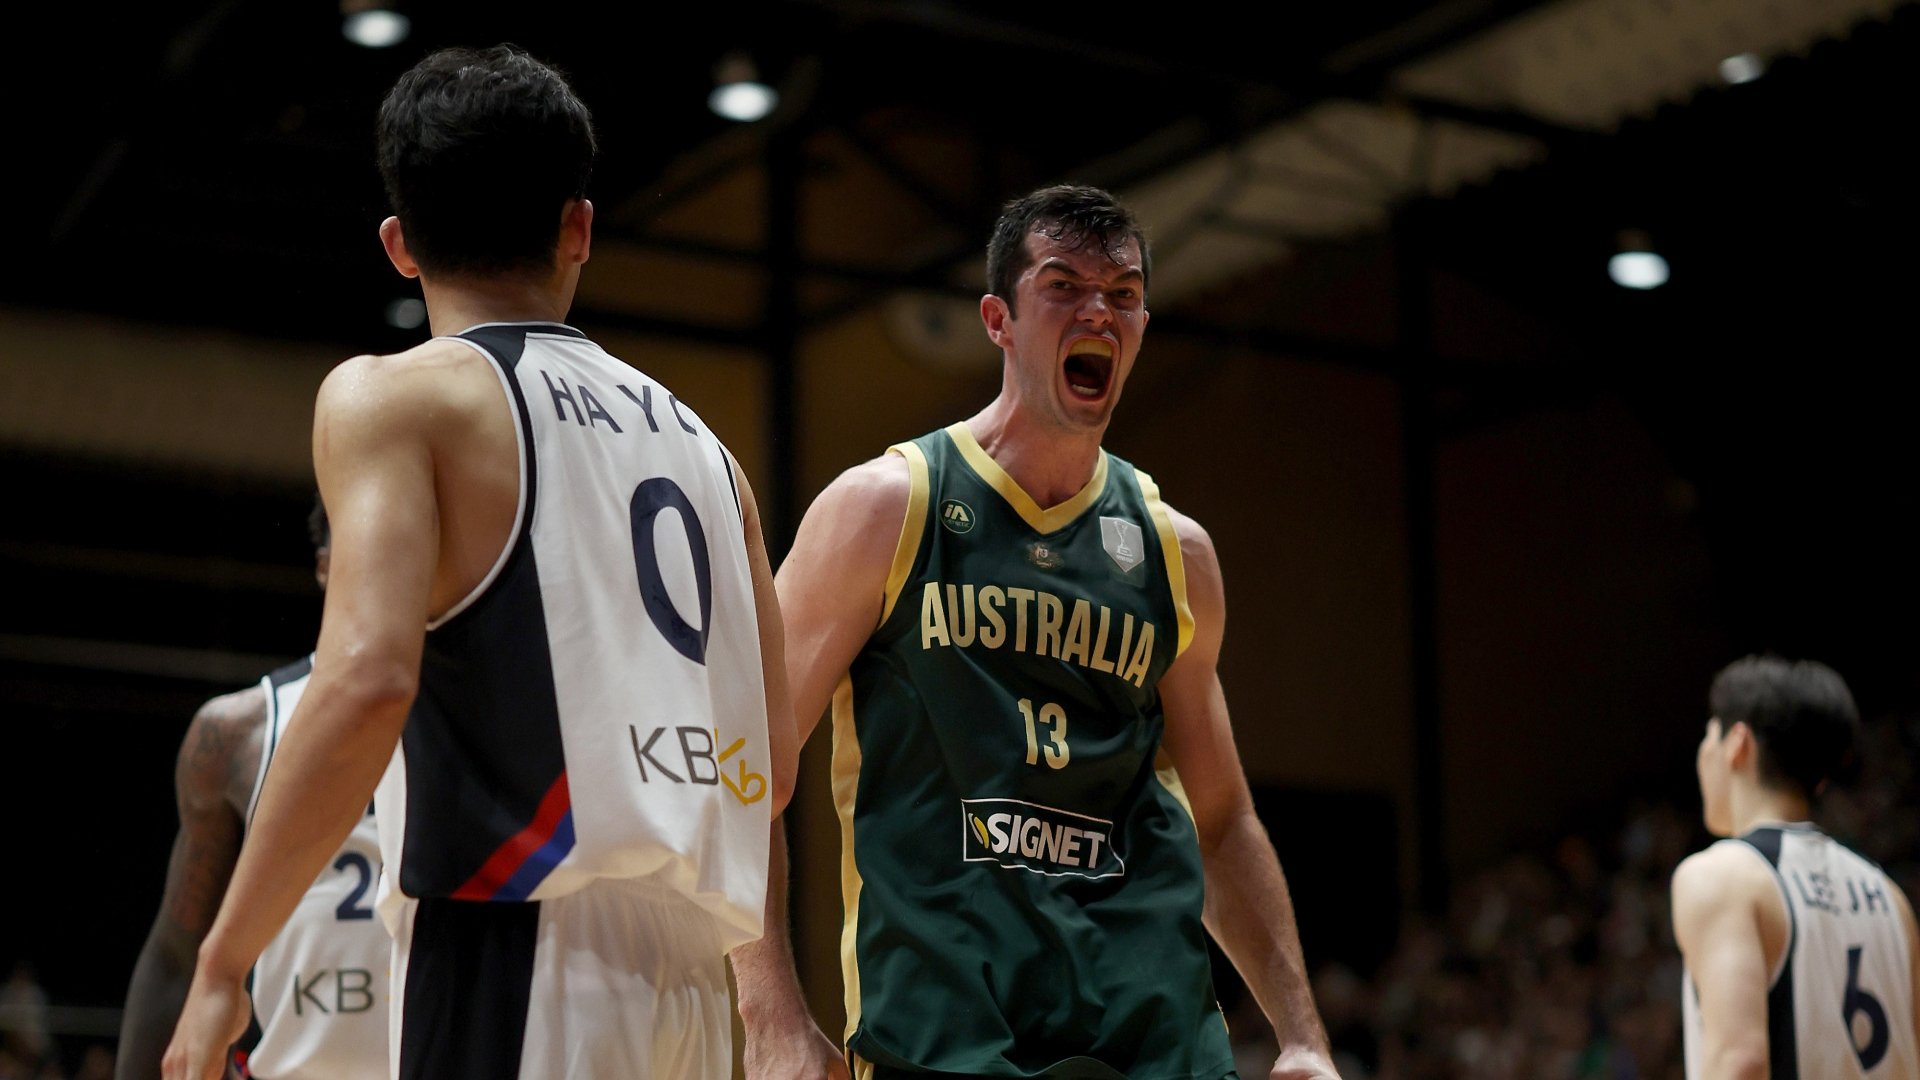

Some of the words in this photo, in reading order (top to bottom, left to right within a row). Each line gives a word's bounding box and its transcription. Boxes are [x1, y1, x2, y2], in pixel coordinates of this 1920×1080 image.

[630, 476, 713, 667] 0
[920, 581, 1156, 689] AUSTRALIA
[1017, 697, 1070, 770] 13
[987, 812, 1106, 870] SIGNET
[293, 967, 376, 1018] KB
[1842, 945, 1890, 1074] 6
